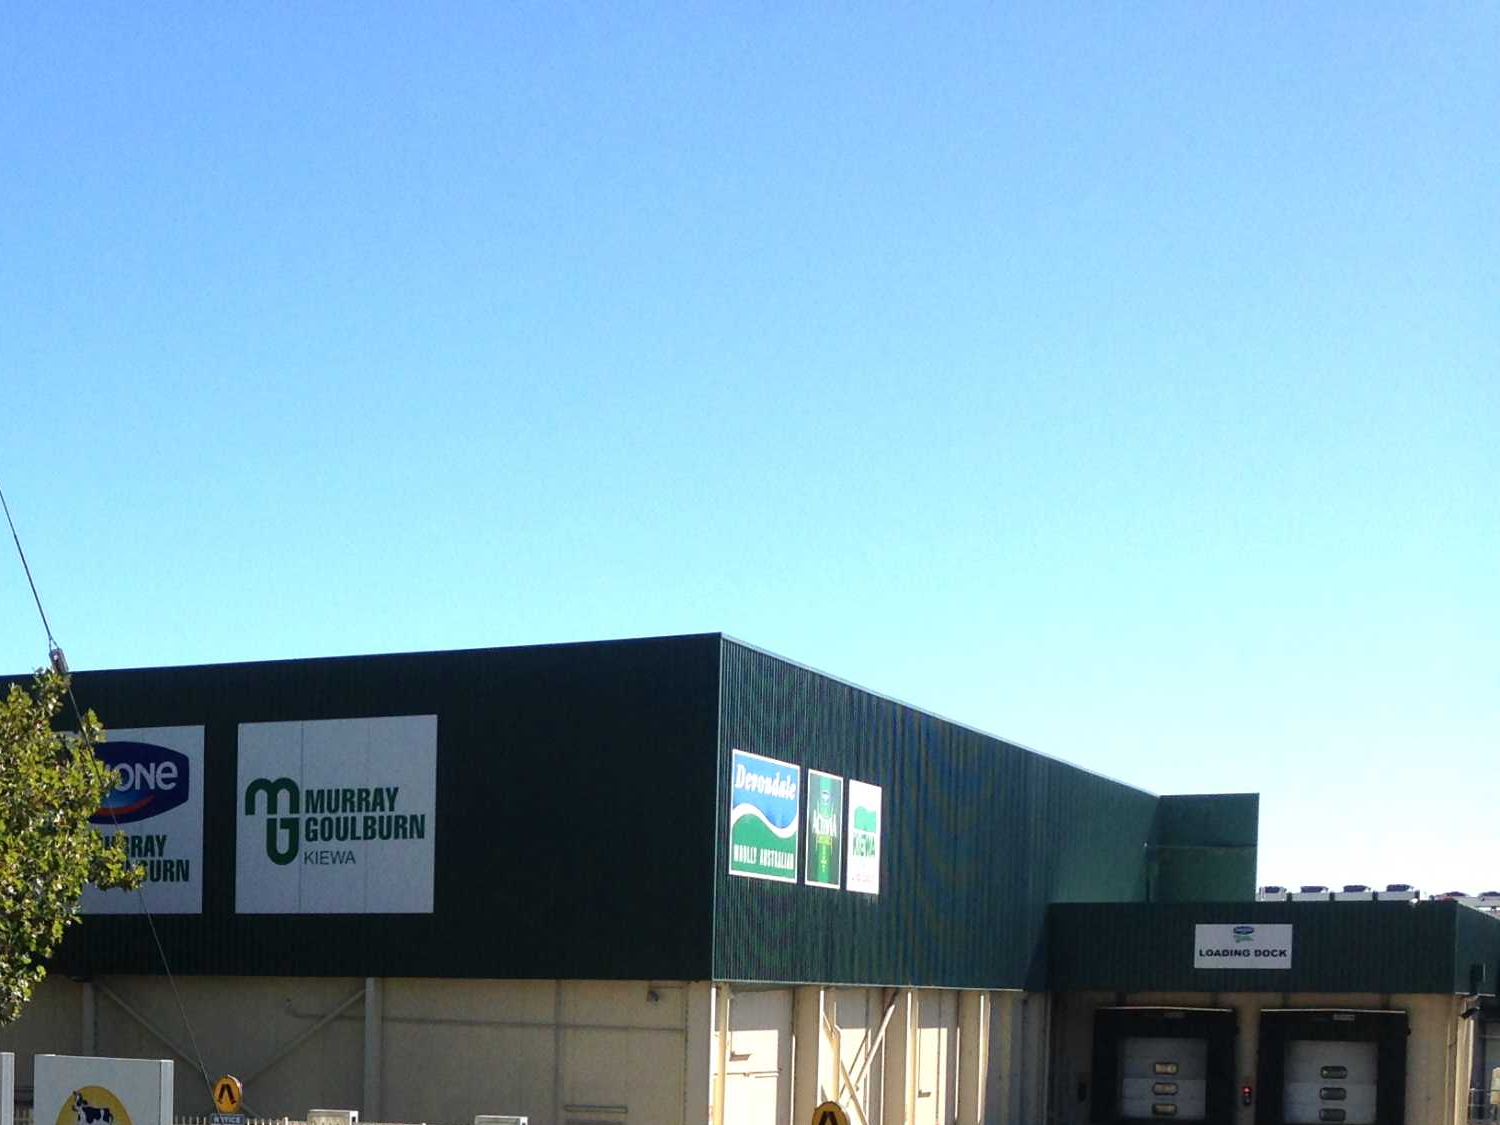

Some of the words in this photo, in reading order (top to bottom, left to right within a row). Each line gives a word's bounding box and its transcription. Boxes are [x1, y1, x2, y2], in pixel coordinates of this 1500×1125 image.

[305, 787, 399, 814] MURRAY
[304, 814, 426, 842] GOULBURN
[304, 851, 357, 865] KIEWA
[1199, 948, 1250, 958] LOADING
[1254, 948, 1287, 958] DOCK
